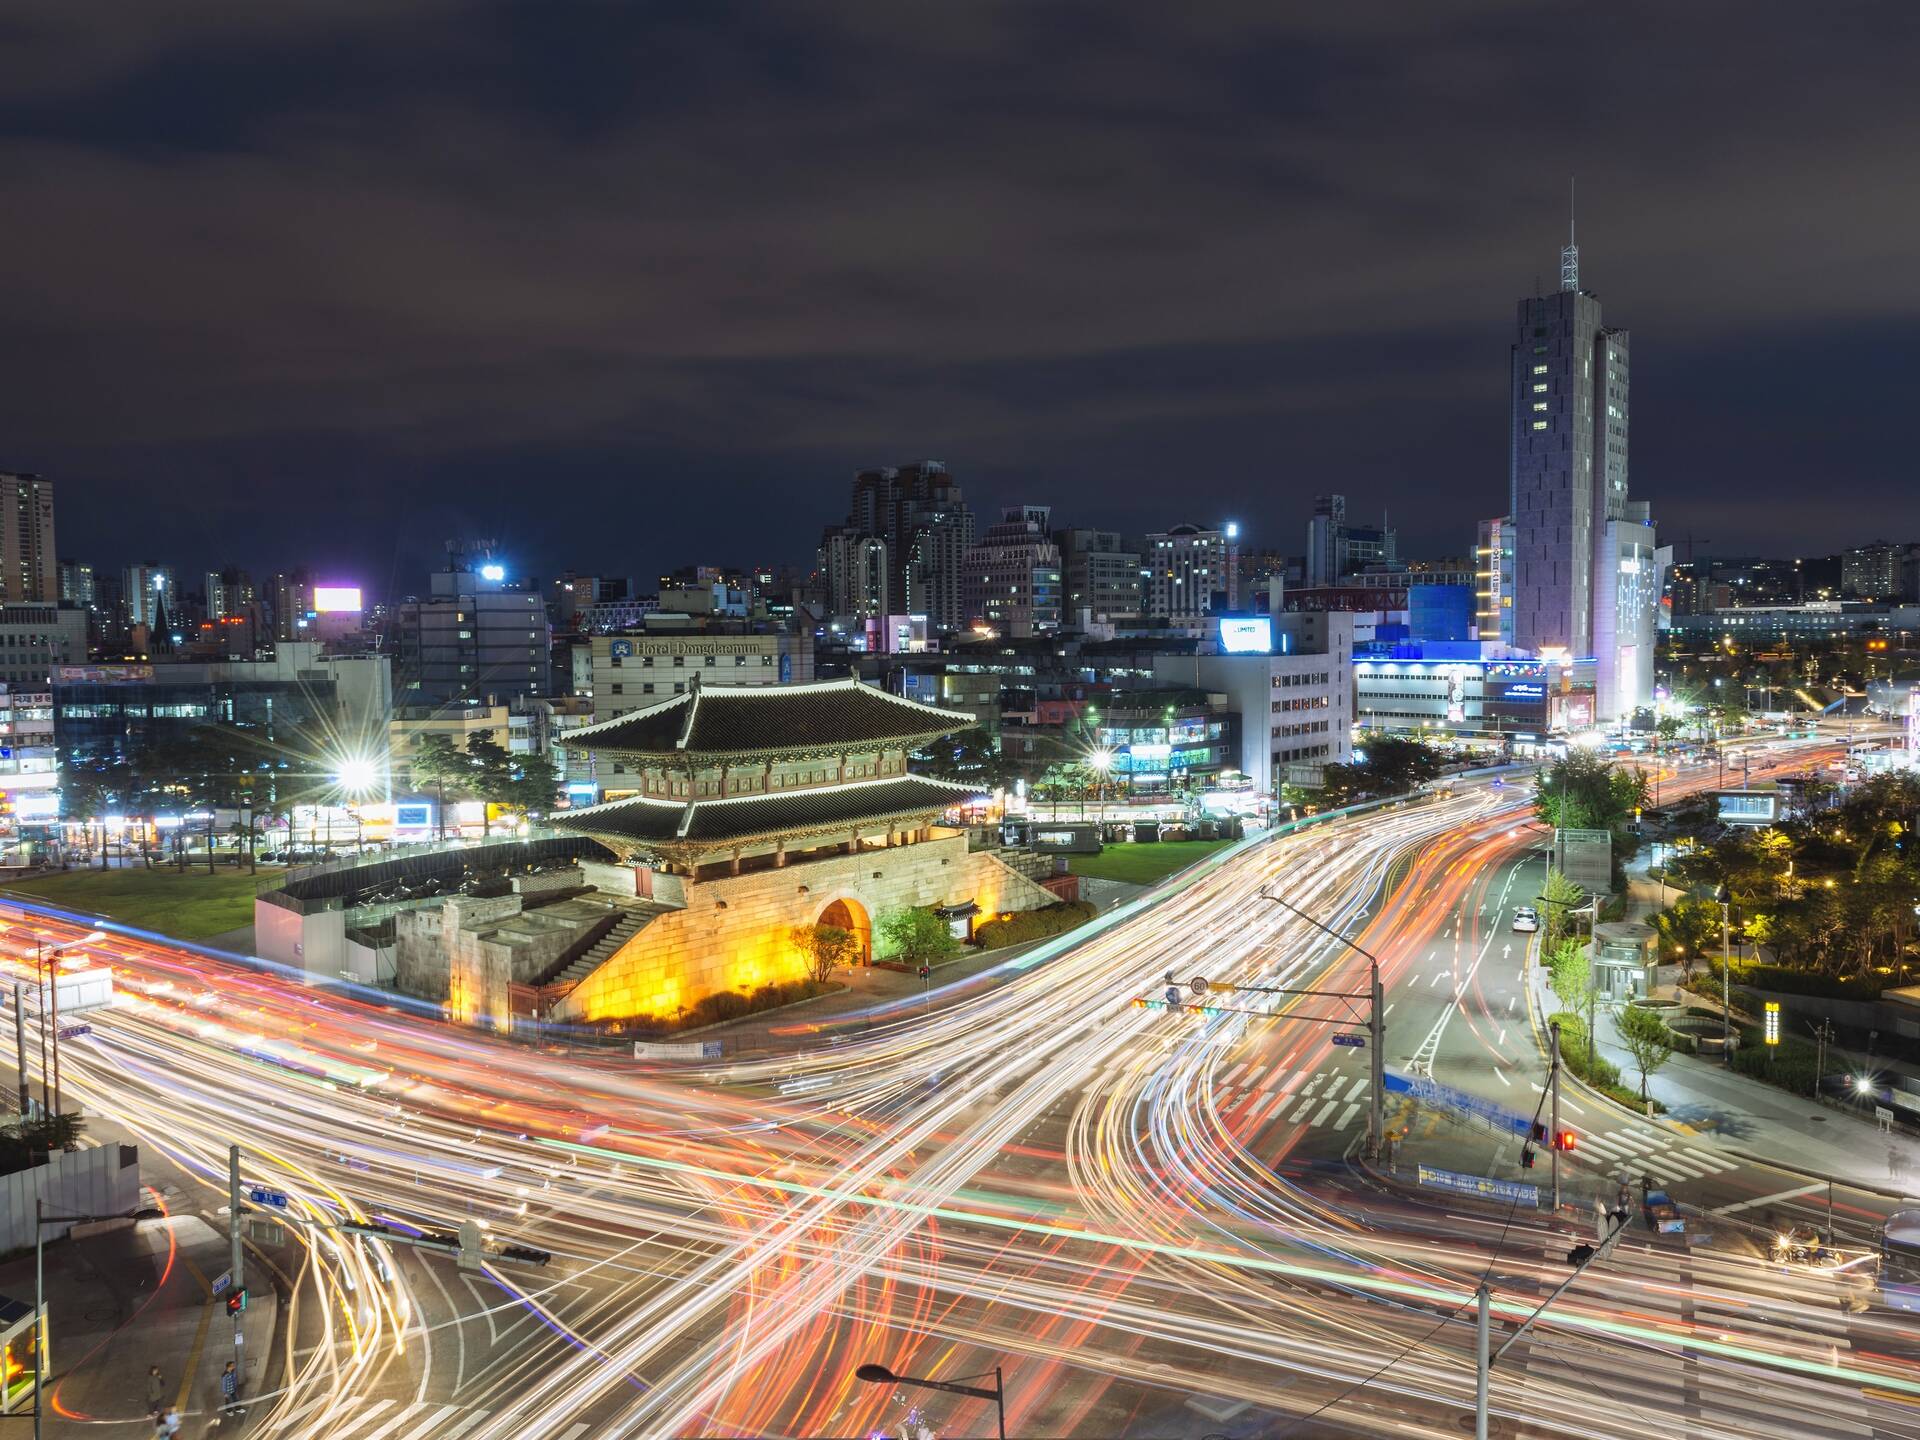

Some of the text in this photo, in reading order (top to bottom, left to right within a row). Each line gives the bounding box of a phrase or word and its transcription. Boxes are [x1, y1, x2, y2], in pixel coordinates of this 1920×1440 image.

[636, 641, 760, 656] Hotel Dongdaemun
[1194, 982, 1205, 991] 60
